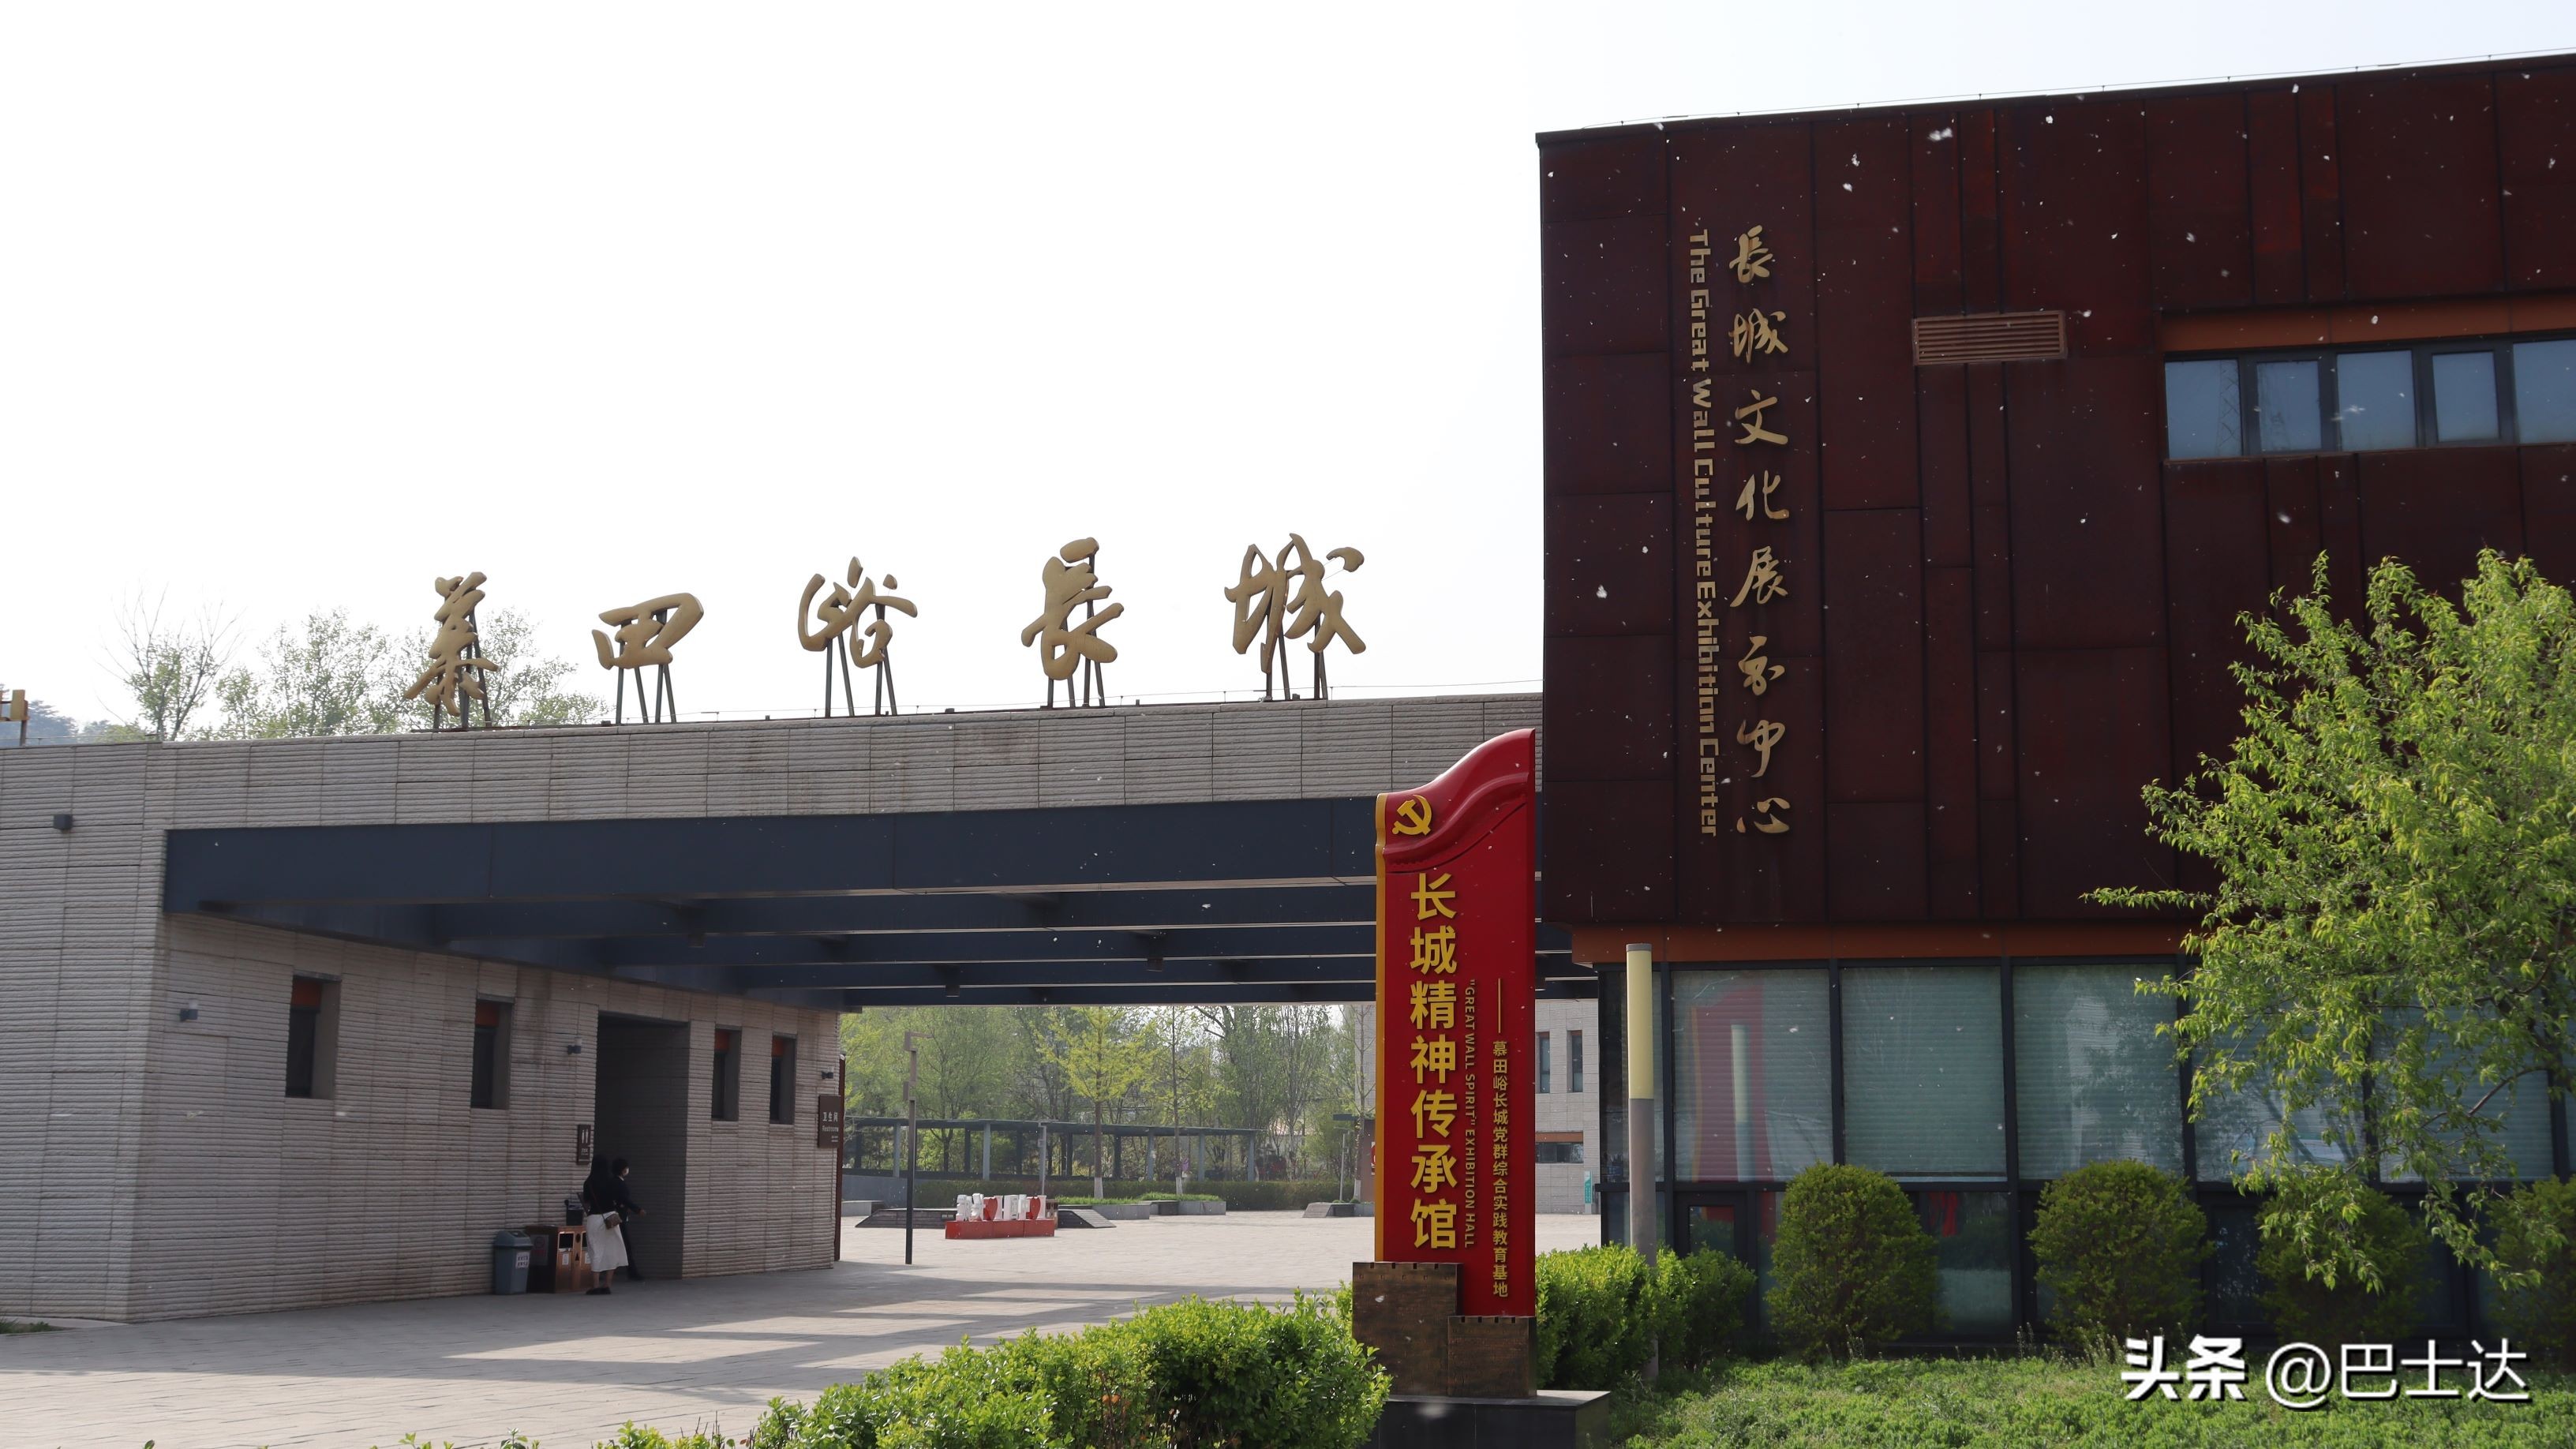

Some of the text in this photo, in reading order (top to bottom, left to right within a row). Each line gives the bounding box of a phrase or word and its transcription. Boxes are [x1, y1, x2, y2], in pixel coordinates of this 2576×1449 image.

[1690, 229, 1711, 283] The
[1690, 289, 1711, 372] Great
[1693, 379, 1715, 452] Wall
[1694, 459, 1717, 576] Culture
[1700, 738, 1719, 837] Center
[1410, 872, 1457, 1249] 长城精神传承馆
[1464, 1033, 1476, 1069] WALL
[1465, 1129, 1477, 1209] EXHIBITION
[1464, 1215, 1477, 1249] HALL
